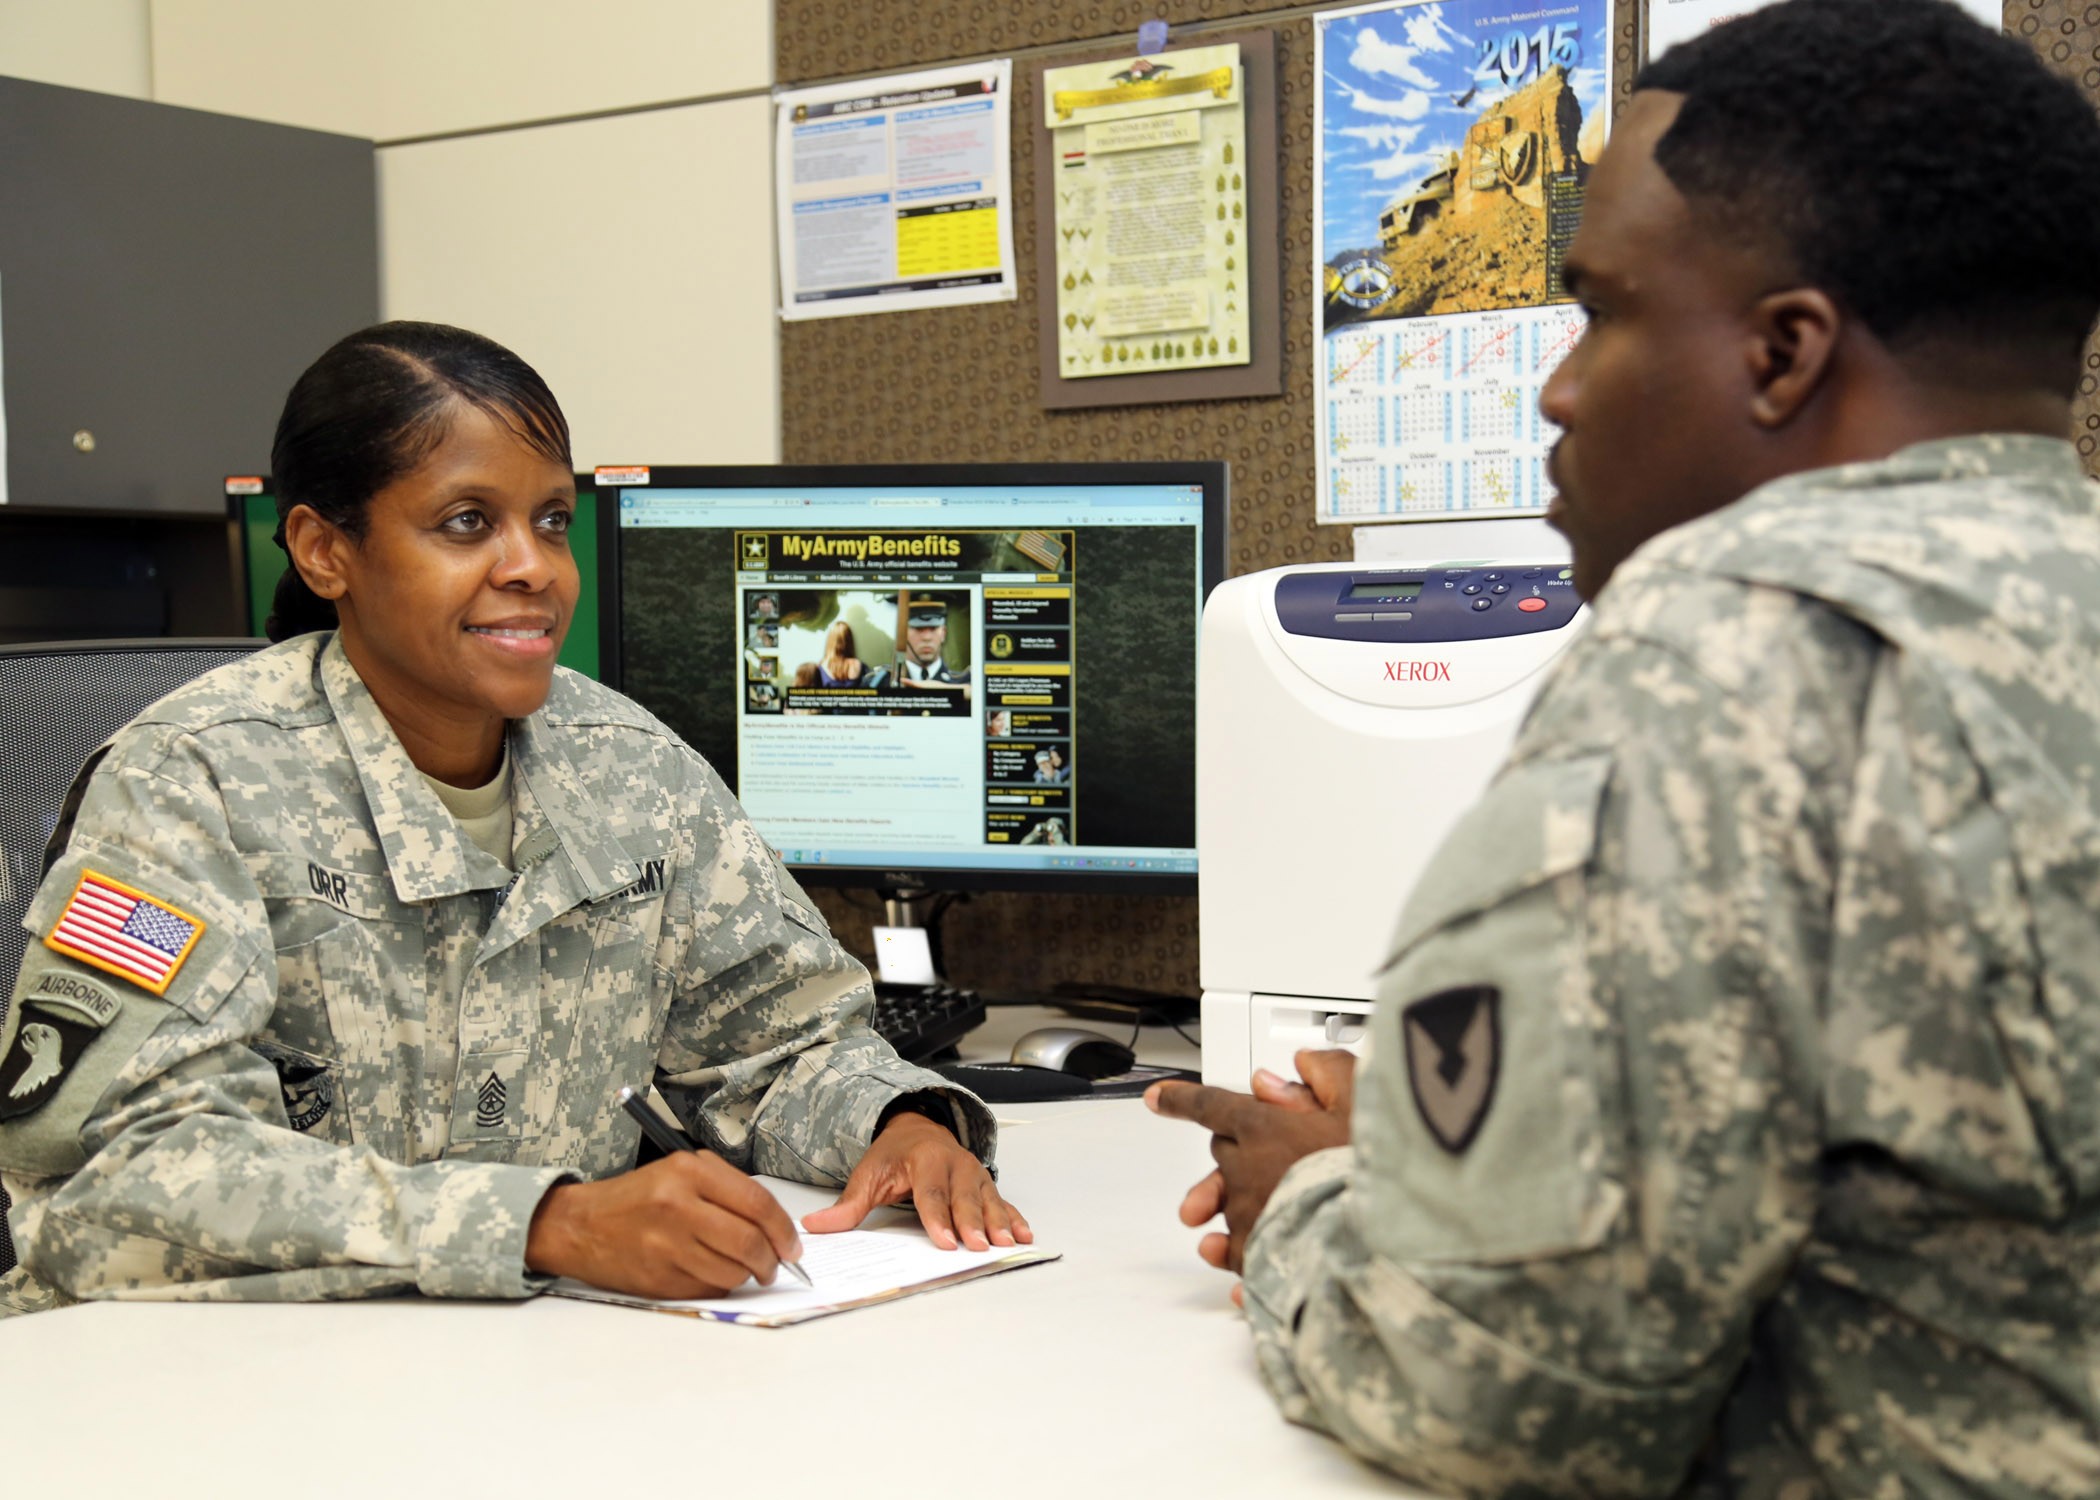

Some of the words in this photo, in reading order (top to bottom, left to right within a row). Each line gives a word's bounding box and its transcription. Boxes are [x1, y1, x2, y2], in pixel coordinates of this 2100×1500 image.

[1541, 5, 1579, 16] Command
[1473, 21, 1580, 86] 2015
[782, 535, 961, 561] MyArmyBenefits
[1383, 661, 1451, 682] XEROX
[308, 862, 350, 909] ORR
[37, 975, 114, 1017] AIRBORNE
